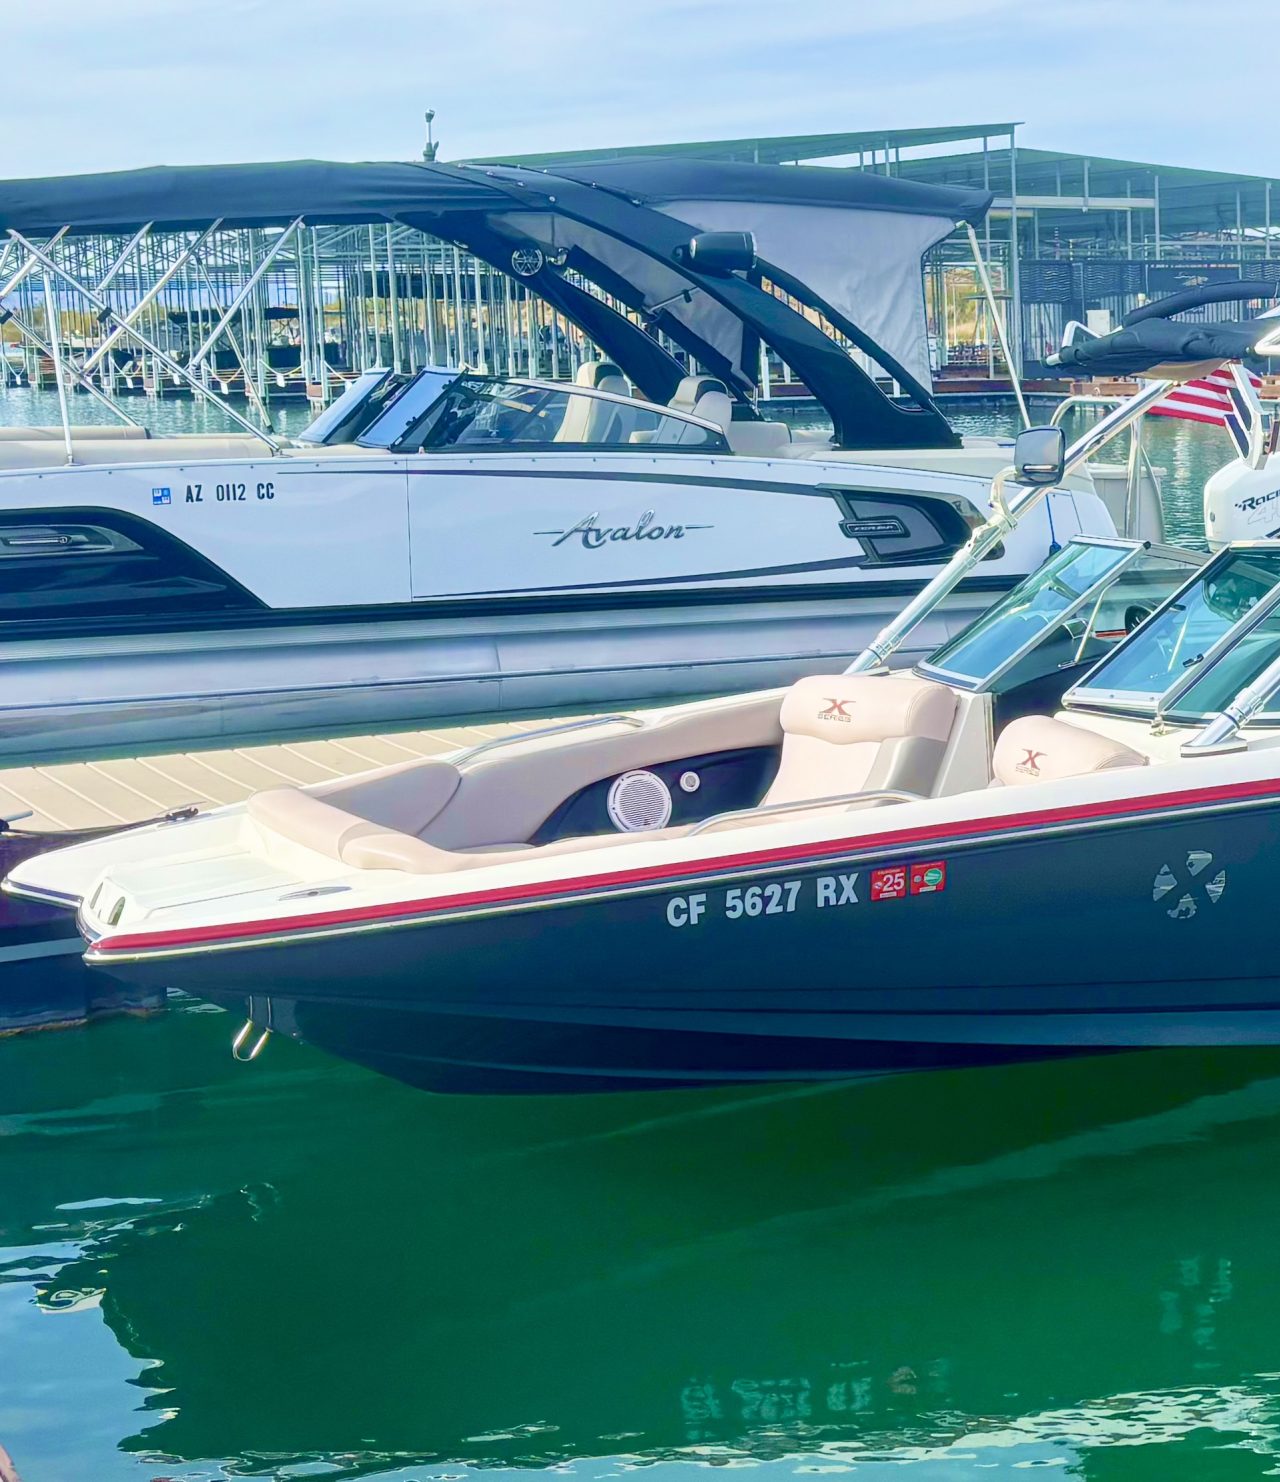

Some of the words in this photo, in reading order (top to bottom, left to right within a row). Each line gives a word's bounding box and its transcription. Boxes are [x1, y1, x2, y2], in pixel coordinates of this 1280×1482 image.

[185, 484, 203, 503] AZ
[257, 482, 274, 500] CC
[551, 508, 685, 550] Avalon
[882, 872, 905, 892] 25
[666, 893, 707, 928] CF
[725, 880, 802, 919] 5627
[816, 872, 860, 908] RX
